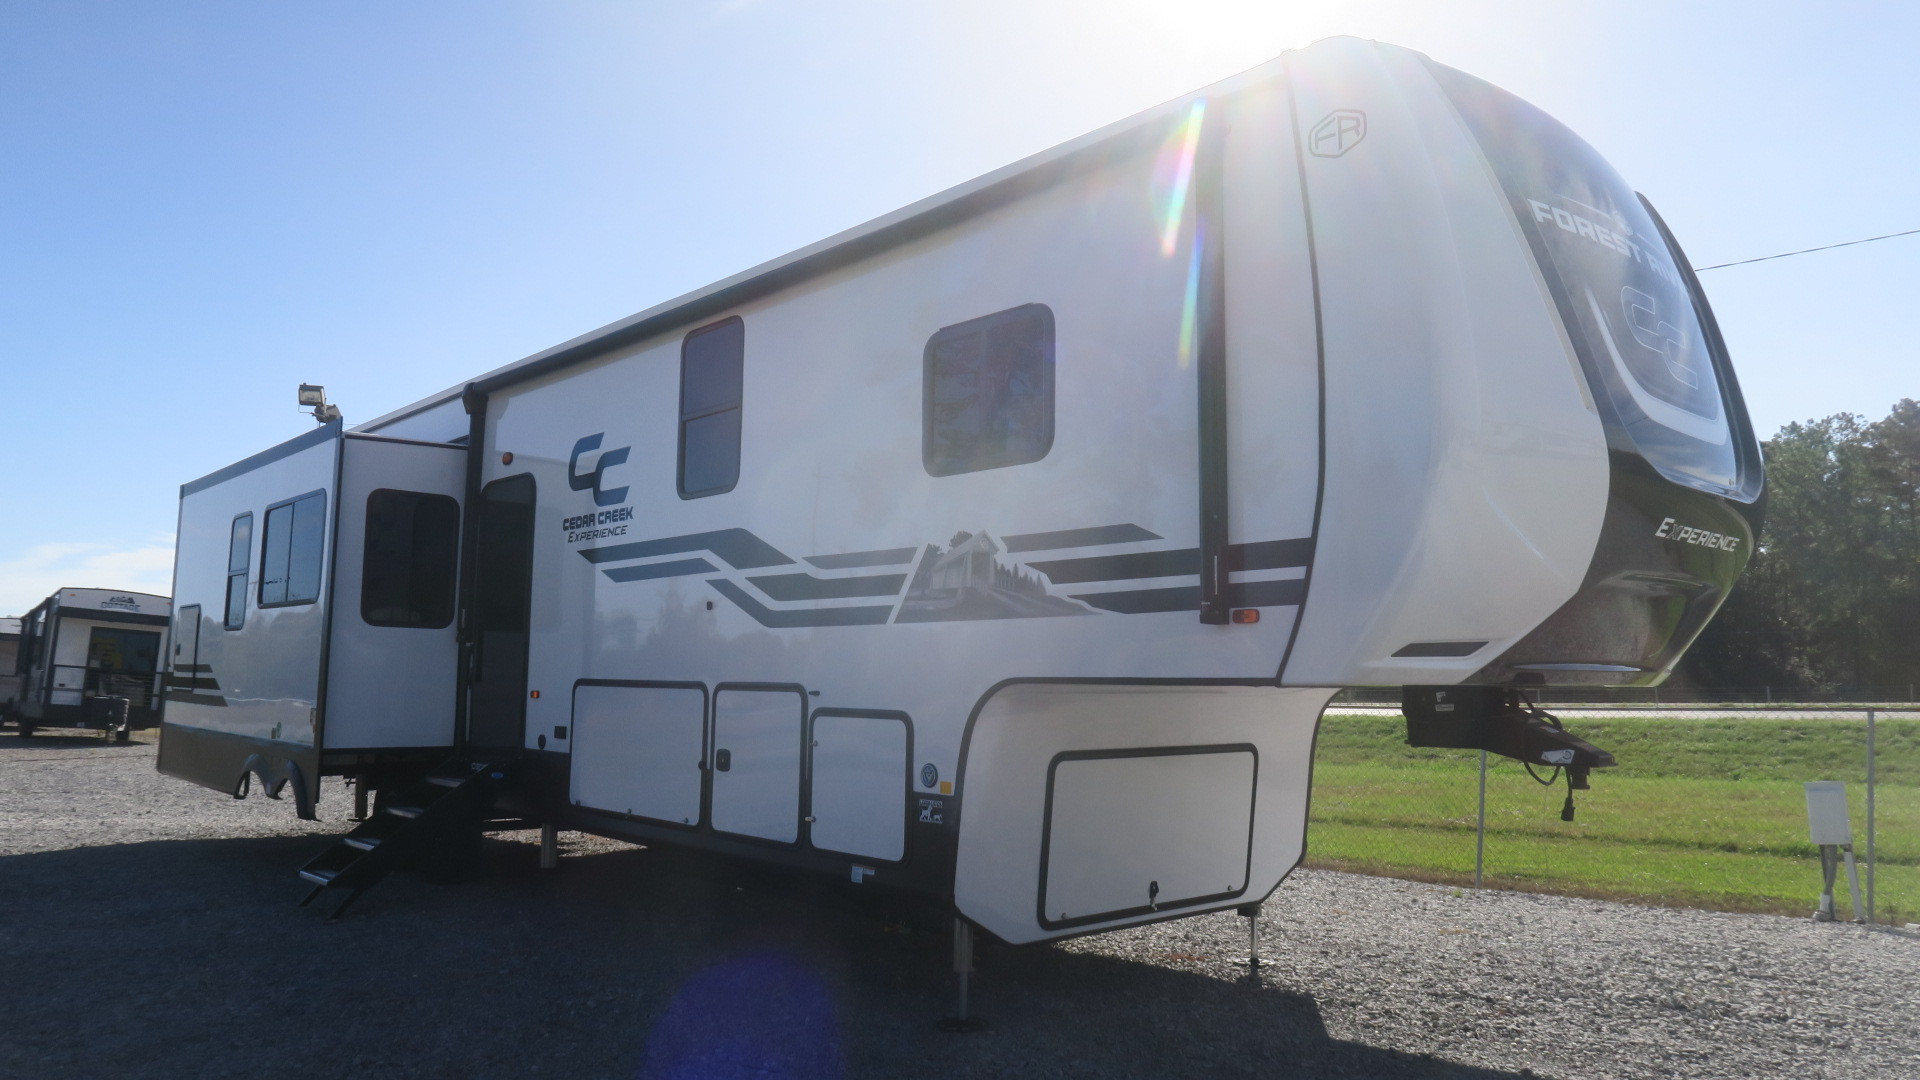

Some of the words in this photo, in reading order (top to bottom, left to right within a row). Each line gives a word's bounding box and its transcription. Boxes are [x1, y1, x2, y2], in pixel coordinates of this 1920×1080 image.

[1527, 199, 1641, 263] FOREST
[562, 513, 596, 532] CEDAR
[597, 506, 634, 525] CREEK
[567, 525, 629, 543] EXPERIENCE
[1655, 517, 1741, 552] EXPERIENCE
